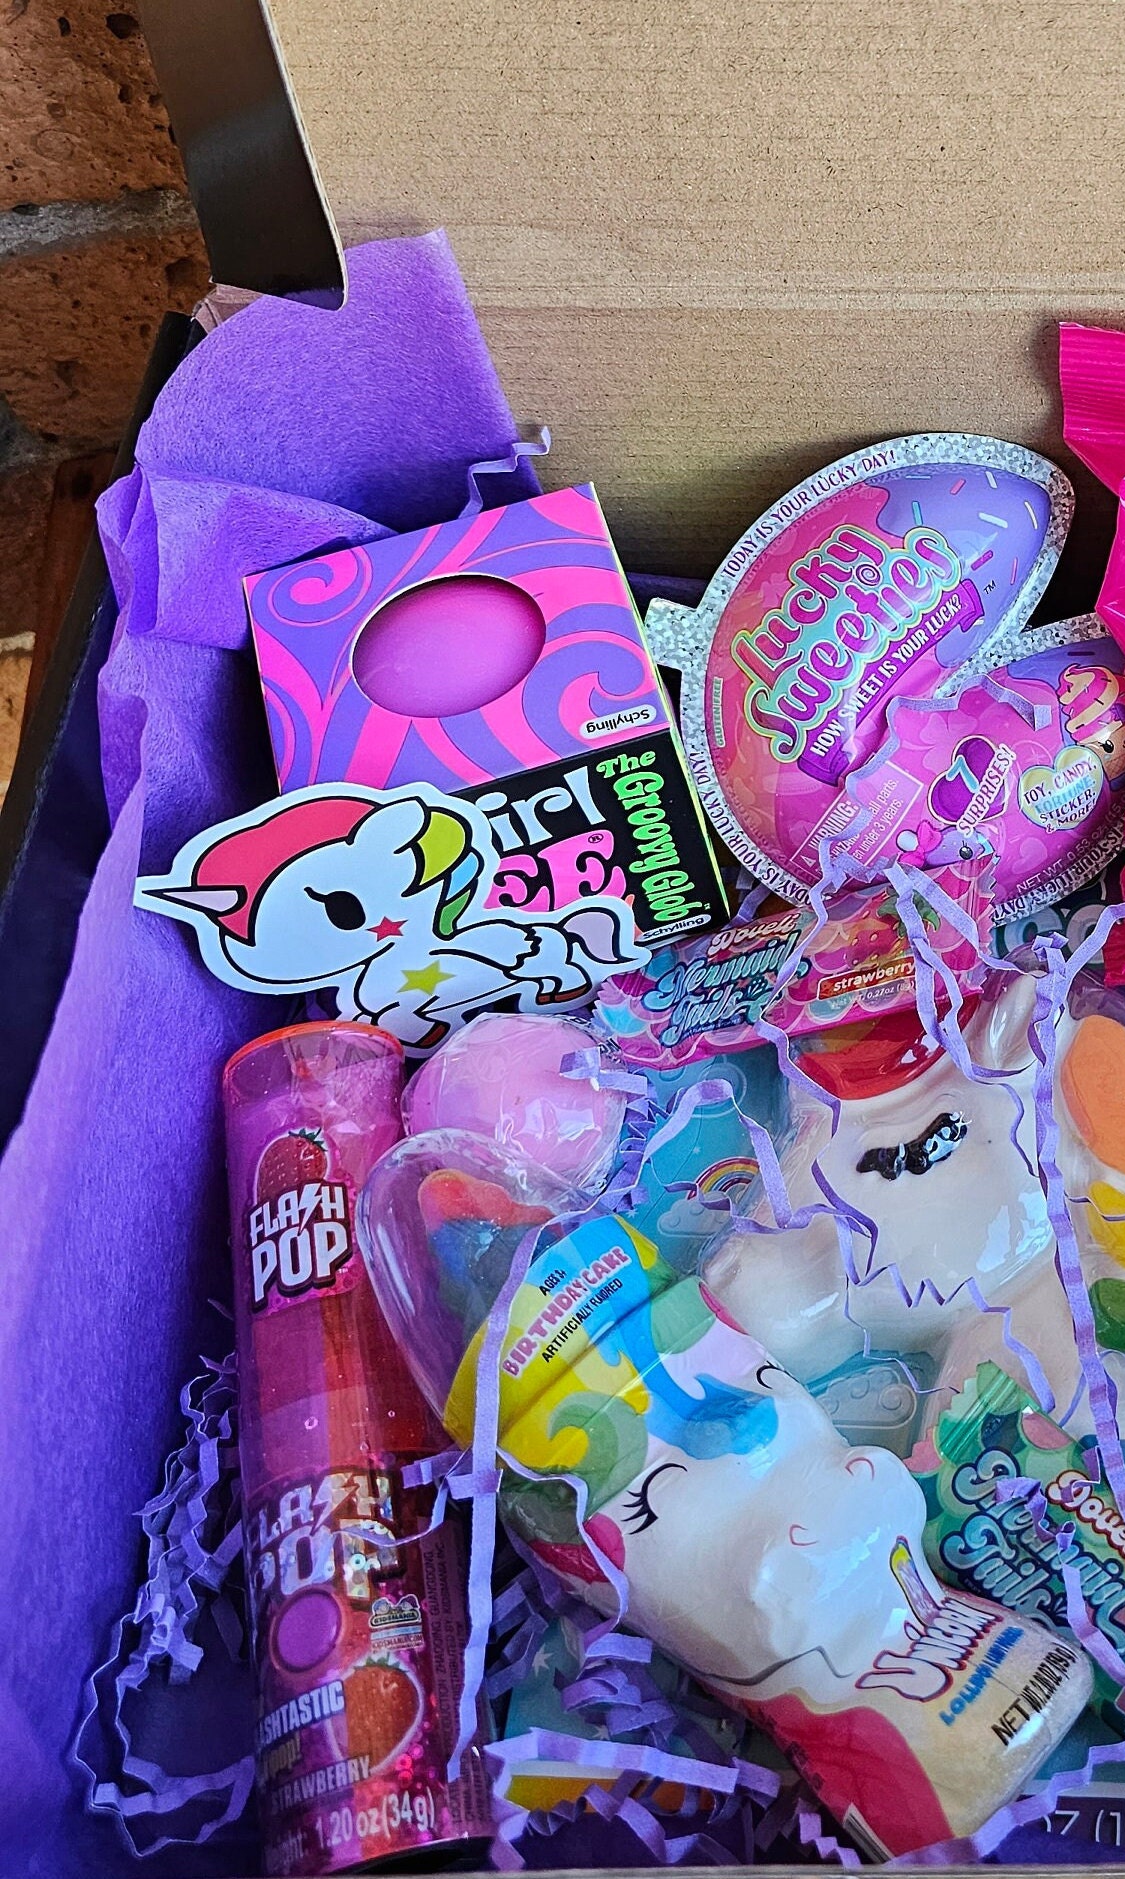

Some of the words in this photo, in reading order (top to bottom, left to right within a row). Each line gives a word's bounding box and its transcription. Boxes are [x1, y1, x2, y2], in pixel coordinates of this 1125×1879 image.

[722, 540, 758, 578] TODAY
[756, 521, 774, 539] IS
[770, 491, 812, 523] YOUR
[811, 465, 858, 496] LUCKY
[861, 450, 896, 472] DAY!
[733, 529, 884, 690] Lucky
[749, 536, 957, 756] Sweeties
[810, 719, 846, 757] HOW
[840, 672, 883, 721] SWEET
[880, 661, 898, 679] IS
[896, 632, 929, 662] YOUR
[925, 594, 963, 635] LUCK?
[586, 708, 650, 734] Schylling
[713, 705, 724, 745] GLUTEN
[596, 751, 656, 779] The
[946, 755, 979, 793] 7
[476, 766, 606, 852] irl
[702, 789, 730, 838] LUCKY
[876, 779, 899, 806] parts.
[958, 747, 1014, 835] SURPRISES!
[1057, 801, 1095, 826] MORE!
[613, 772, 681, 873] Groovy
[860, 828, 880, 853] under
[873, 820, 886, 832] 3
[882, 799, 904, 827] years.
[727, 836, 767, 875] YOUR
[761, 866, 776, 884] IS
[1016, 876, 1042, 894] NET
[1044, 859, 1063, 877] WT
[1066, 840, 1091, 861] 0.53
[641, 871, 703, 922] Glob
[776, 880, 817, 906] ODAY
[643, 916, 705, 938] Schylling
[708, 913, 801, 953] Doveli
[833, 962, 915, 991] strawberry
[250, 1183, 345, 1247] FLASH
[252, 1222, 347, 1302] POP
[539, 1272, 560, 1296] AGES
[502, 1278, 590, 1376] BIRTHDAY
[581, 1246, 632, 1286] CAKE
[258, 1473, 393, 1549] LASH
[991, 1699, 1030, 1746] NET
[271, 1756, 370, 1811] STRAWBERRY
[315, 1807, 353, 1849] 1.20
[357, 1808, 379, 1838] oz
